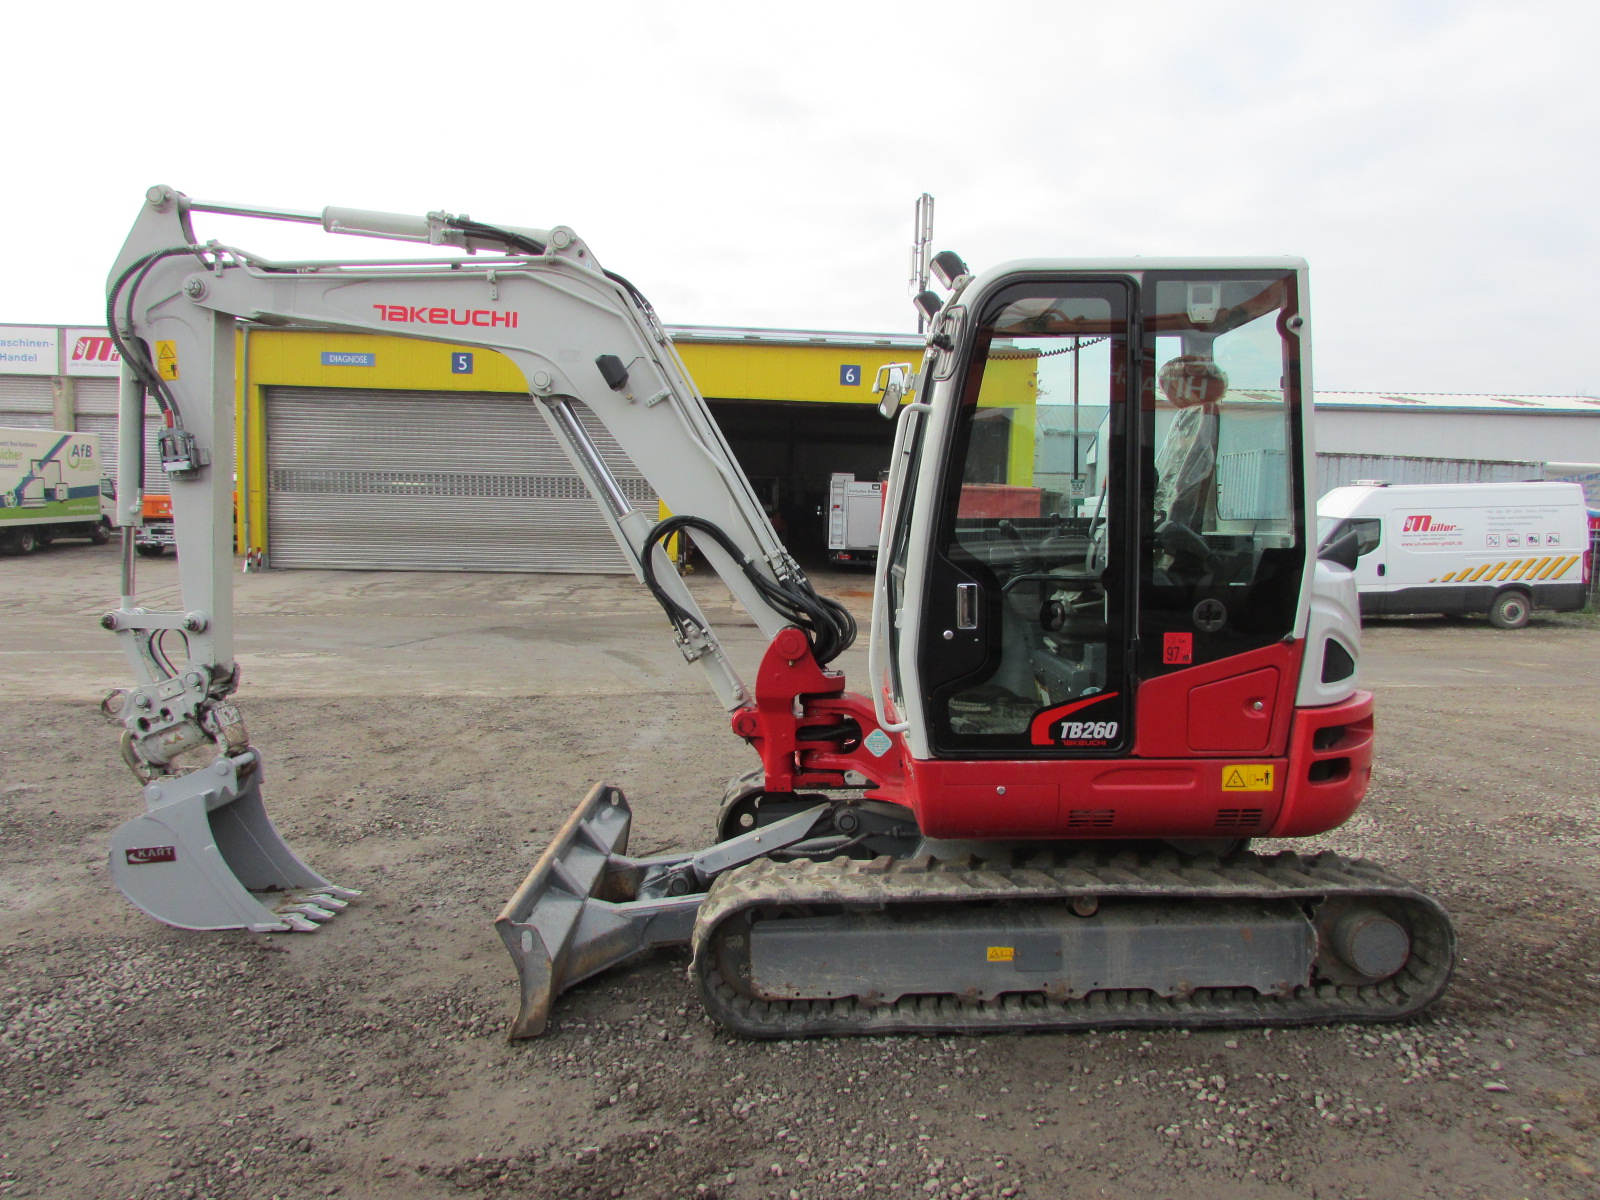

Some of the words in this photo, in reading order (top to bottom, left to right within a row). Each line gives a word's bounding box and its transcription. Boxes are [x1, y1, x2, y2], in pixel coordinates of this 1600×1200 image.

[373, 304, 518, 328] TAKEUCHI
[0, 354, 38, 362] Handel
[329, 354, 368, 364] DIAGNOSE
[458, 356, 467, 371] 5
[845, 368, 855, 383] 6
[72, 444, 93, 457] AfB
[1403, 515, 1457, 532] Müller
[1166, 646, 1180, 661] 97
[1061, 721, 1118, 739] TB260
[137, 847, 173, 858] KART
